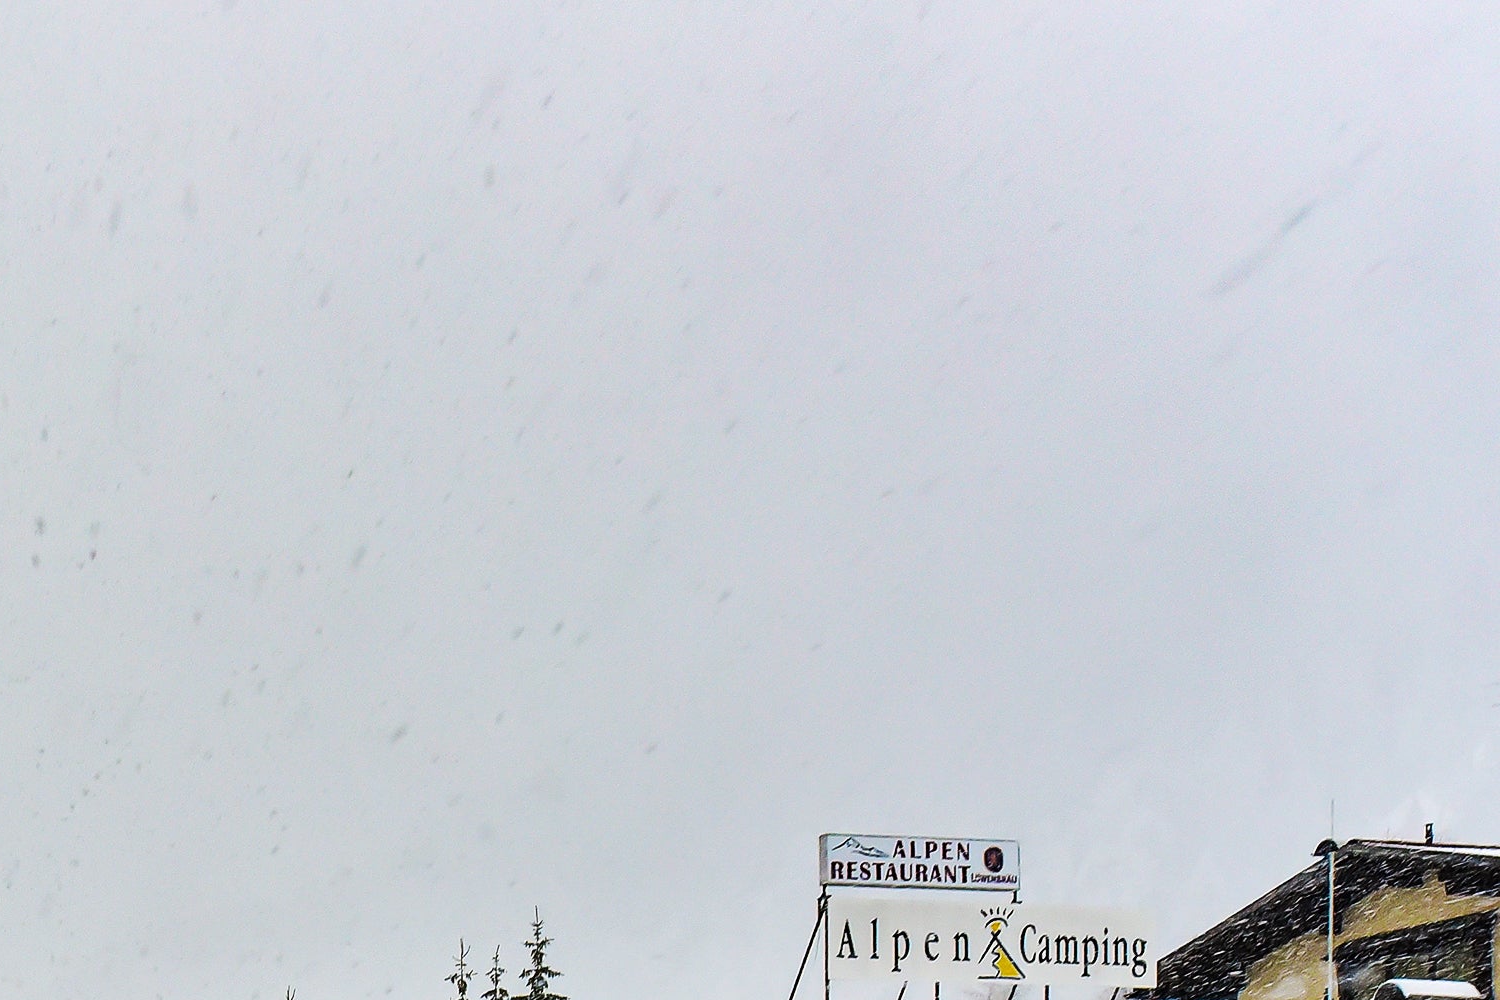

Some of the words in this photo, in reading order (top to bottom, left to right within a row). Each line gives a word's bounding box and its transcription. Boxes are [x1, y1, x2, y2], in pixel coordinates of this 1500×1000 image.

[892, 839, 971, 861] ALPEN
[829, 860, 971, 884] RESTAURANT
[836, 918, 971, 972] Alpen
[1019, 923, 1148, 978] Camping
